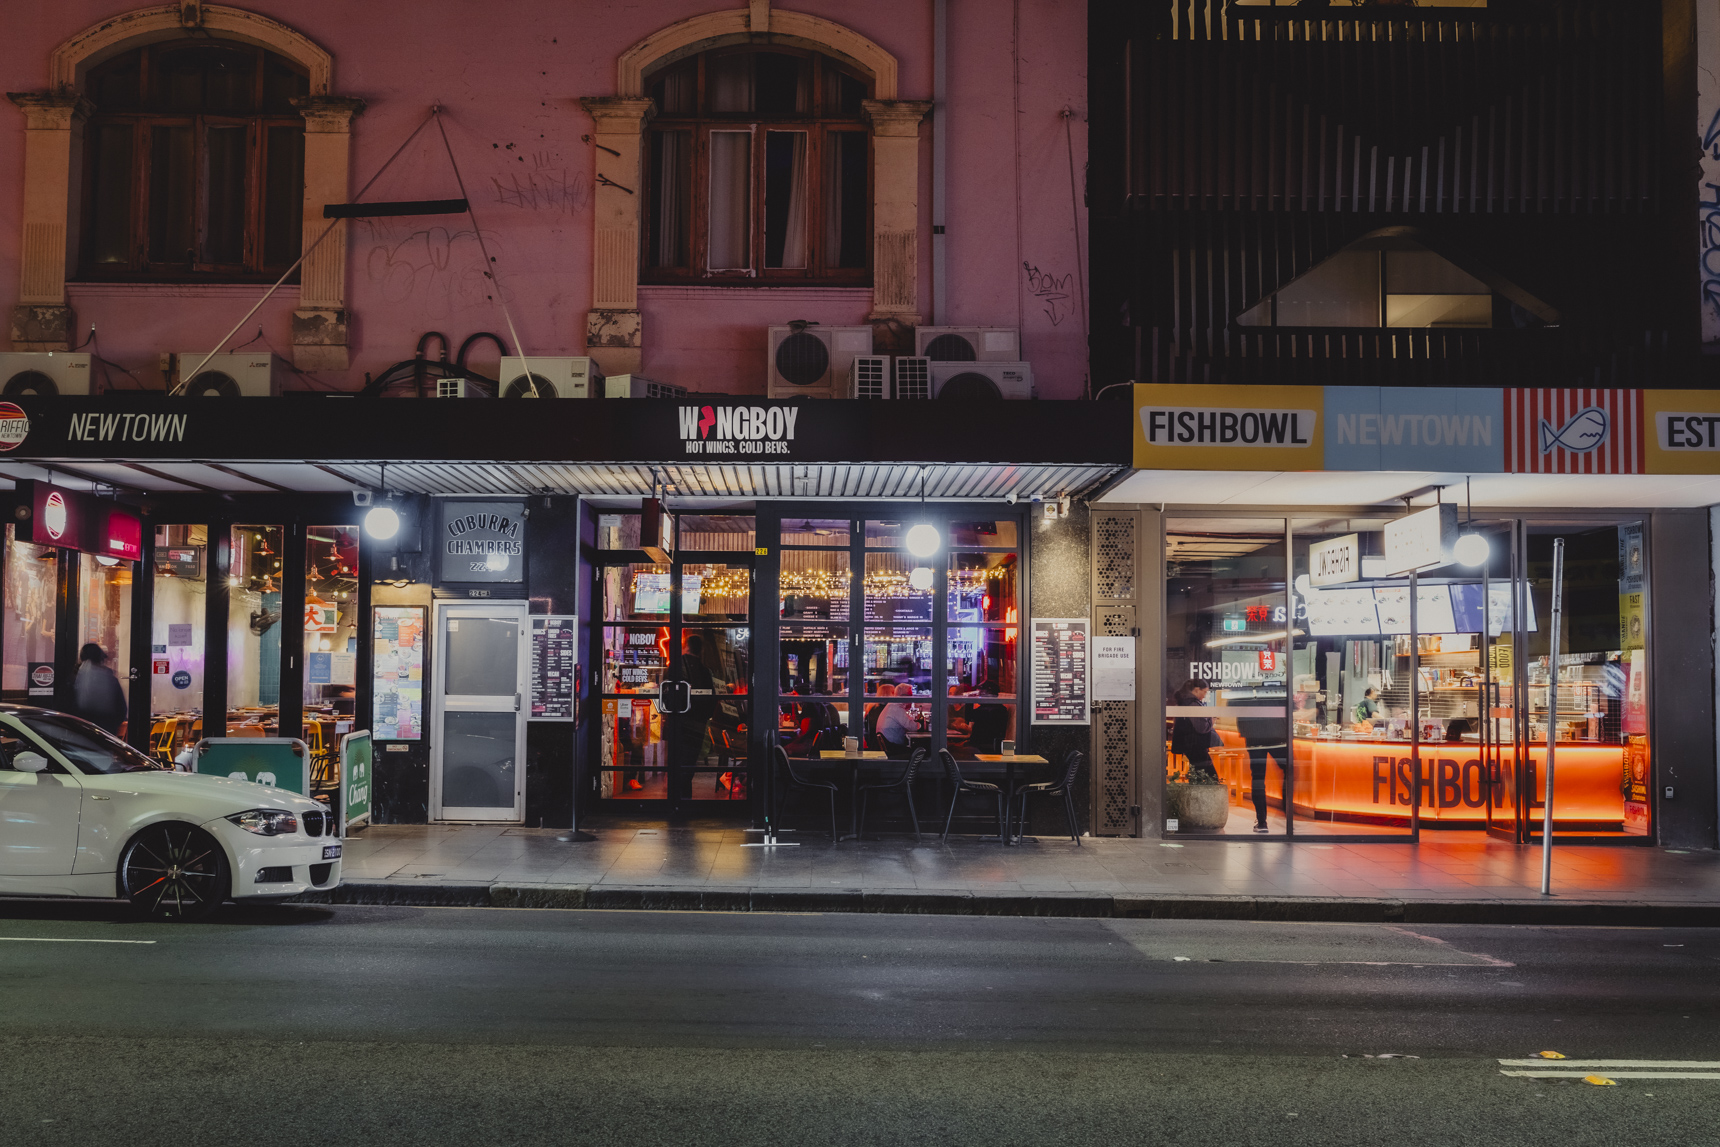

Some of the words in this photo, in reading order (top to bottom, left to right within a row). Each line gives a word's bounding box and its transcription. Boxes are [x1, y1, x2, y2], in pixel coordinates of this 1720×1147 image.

[68, 413, 187, 441] NEWTOWN
[1149, 411, 1307, 444] FISHBOWL
[1337, 413, 1492, 447] NEWTOWN
[1668, 414, 1720, 447] EST
[686, 441, 704, 453] HOT
[706, 441, 737, 453] WINGS.
[739, 441, 763, 453] COLD
[765, 441, 790, 453] BEVS.
[447, 513, 519, 539] COBURRA
[447, 540, 521, 555] CHAMBERS
[1630, 594, 1640, 604] FAST
[1190, 662, 1262, 680] FISHBOWL
[348, 783, 368, 806] Chang
